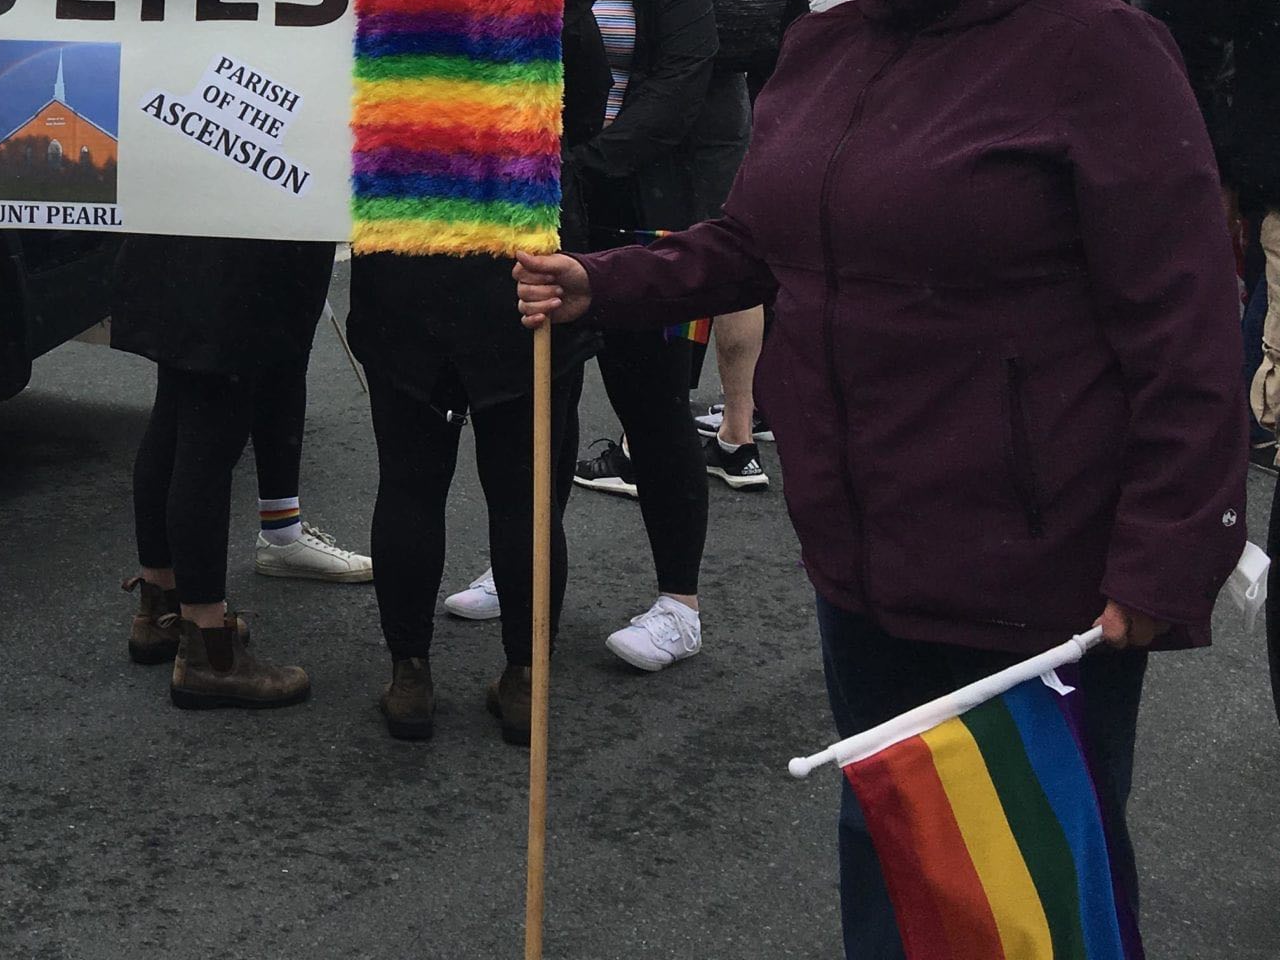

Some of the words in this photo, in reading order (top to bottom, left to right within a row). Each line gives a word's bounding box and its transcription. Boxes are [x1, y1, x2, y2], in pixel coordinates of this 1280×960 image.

[202, 85, 236, 110] OF
[237, 100, 285, 139] THE
[214, 56, 301, 113] PARISH
[141, 93, 311, 195] ASCENSION
[46, 205, 123, 226] PEARL
